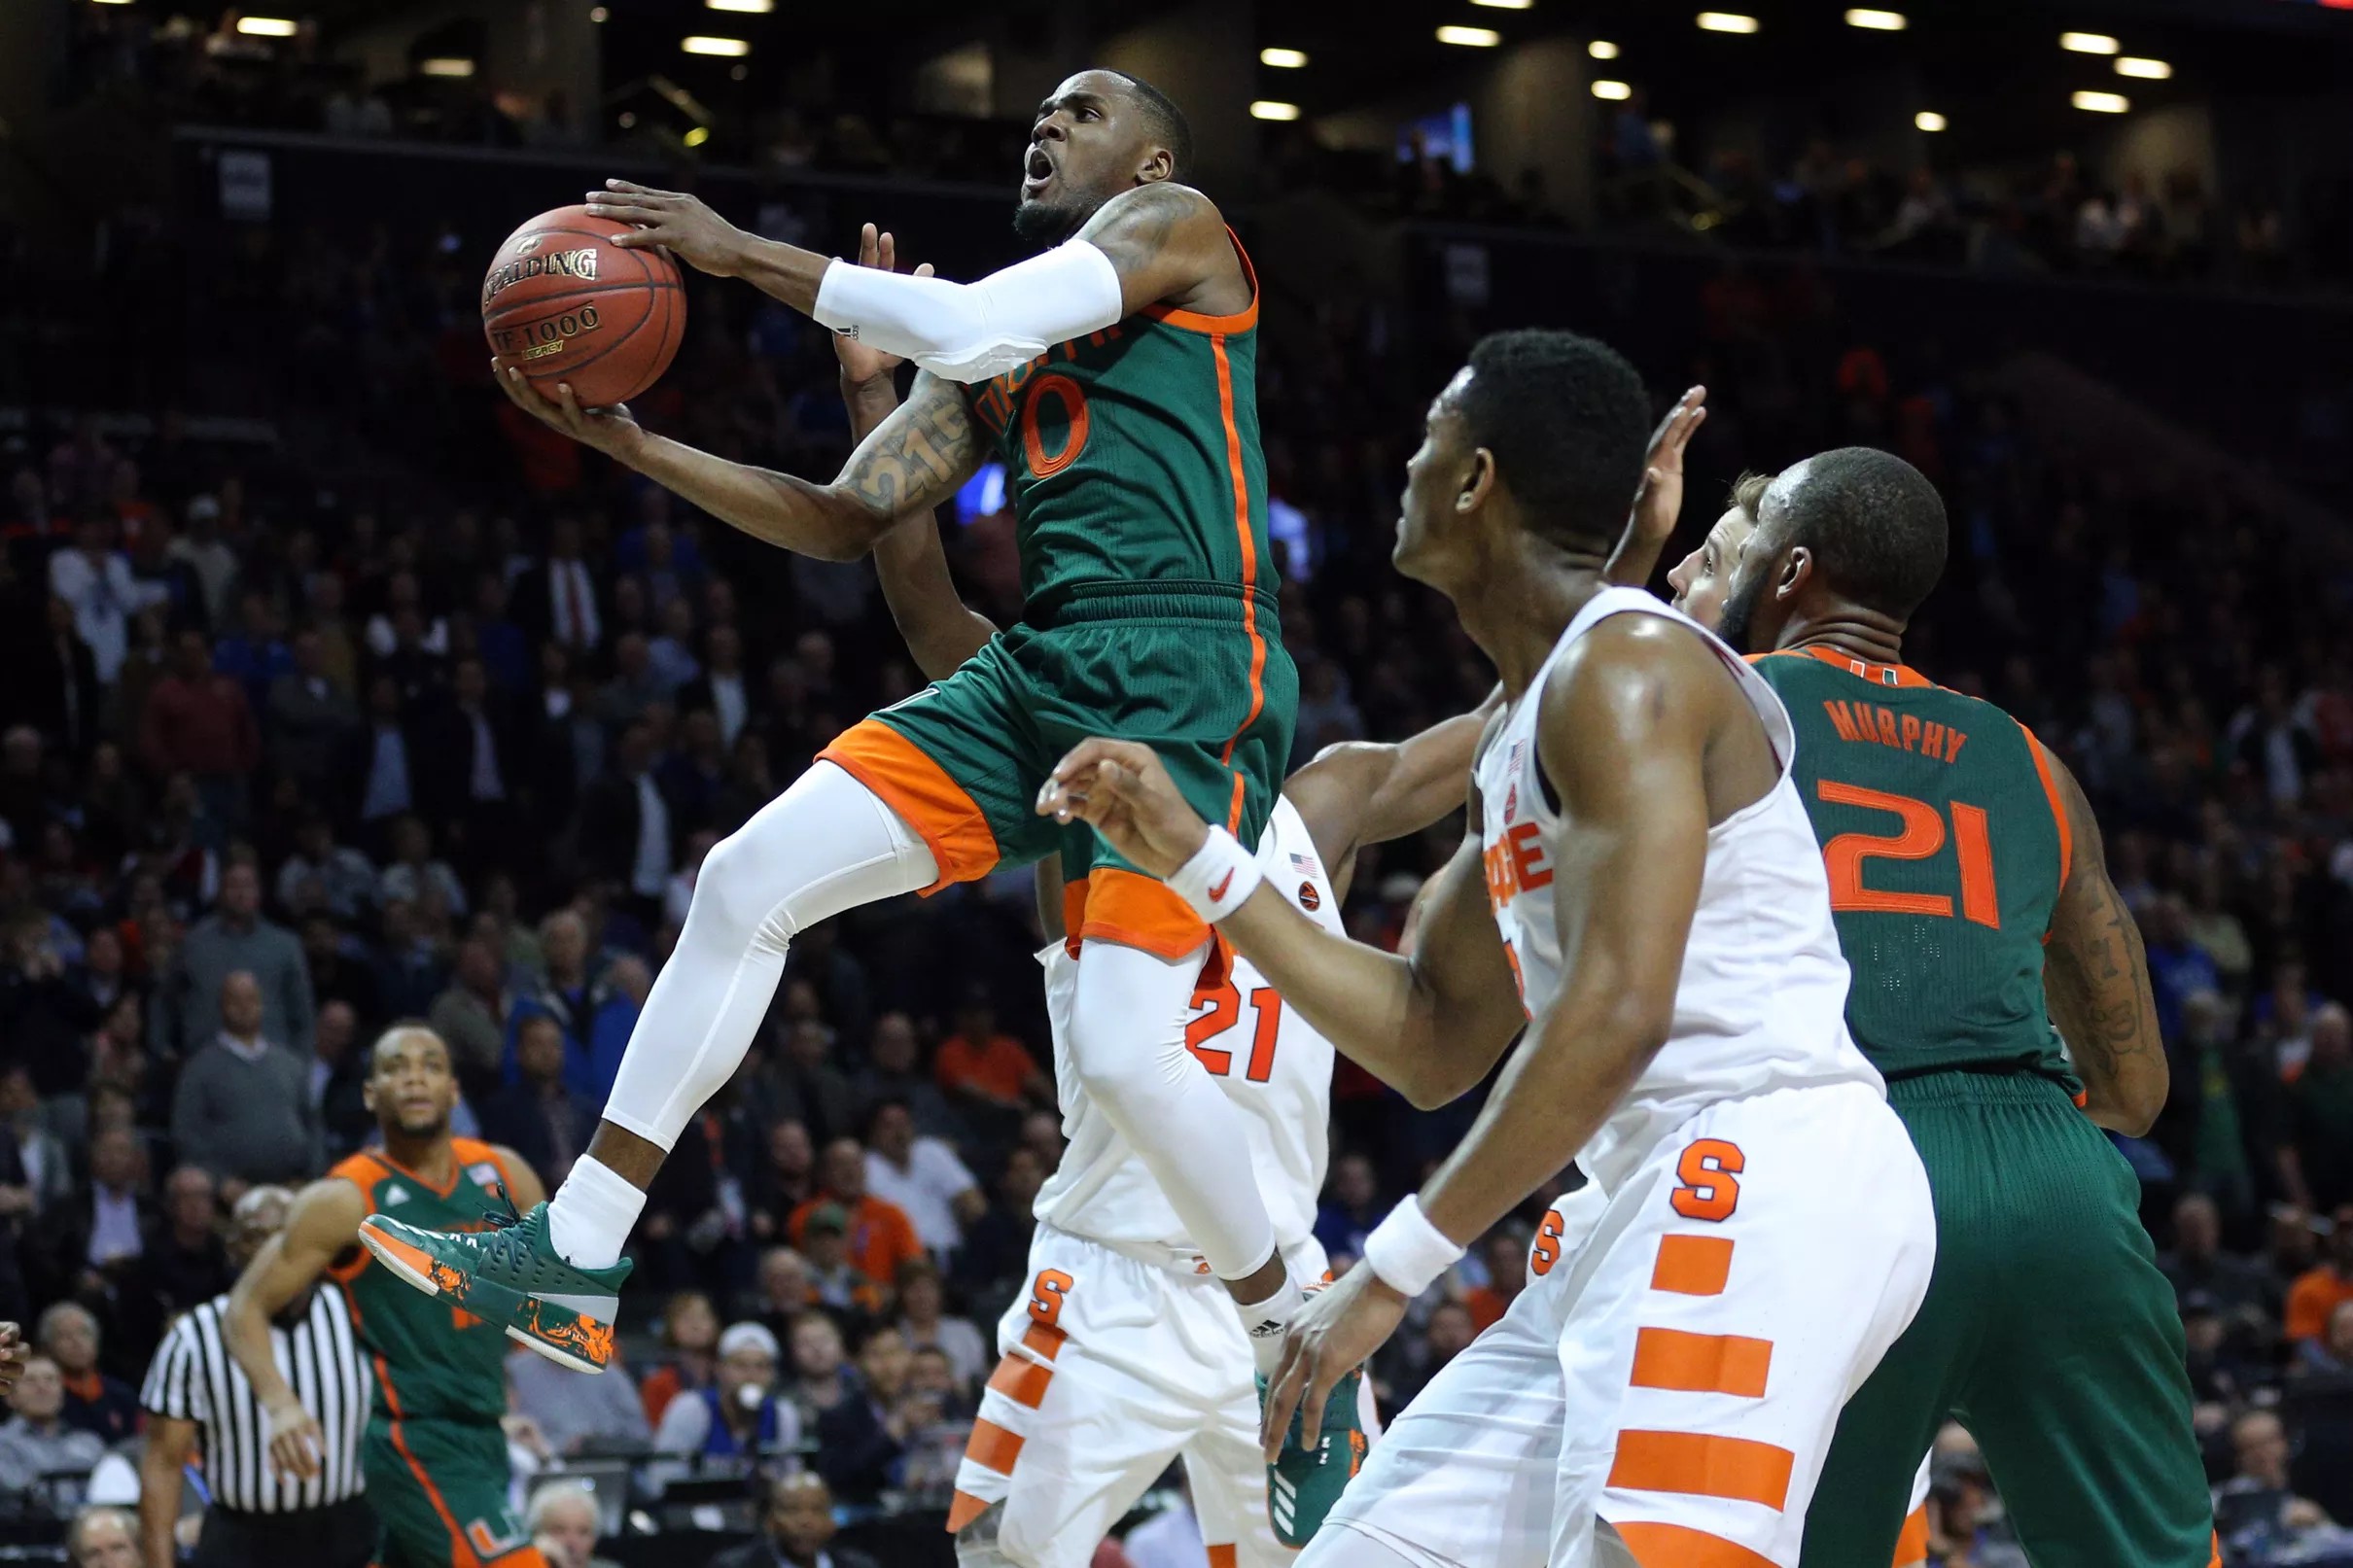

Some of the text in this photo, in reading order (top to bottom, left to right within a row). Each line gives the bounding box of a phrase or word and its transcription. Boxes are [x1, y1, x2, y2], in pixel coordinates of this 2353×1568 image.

[1023, 374, 1089, 477] 0
[1823, 701, 1968, 764] MURPHY
[1817, 779, 1999, 930] 21
[1184, 980, 1282, 1082] 21
[1669, 1137, 1745, 1222] S
[1531, 1209, 1564, 1276] S
[1027, 1268, 1074, 1325] S
